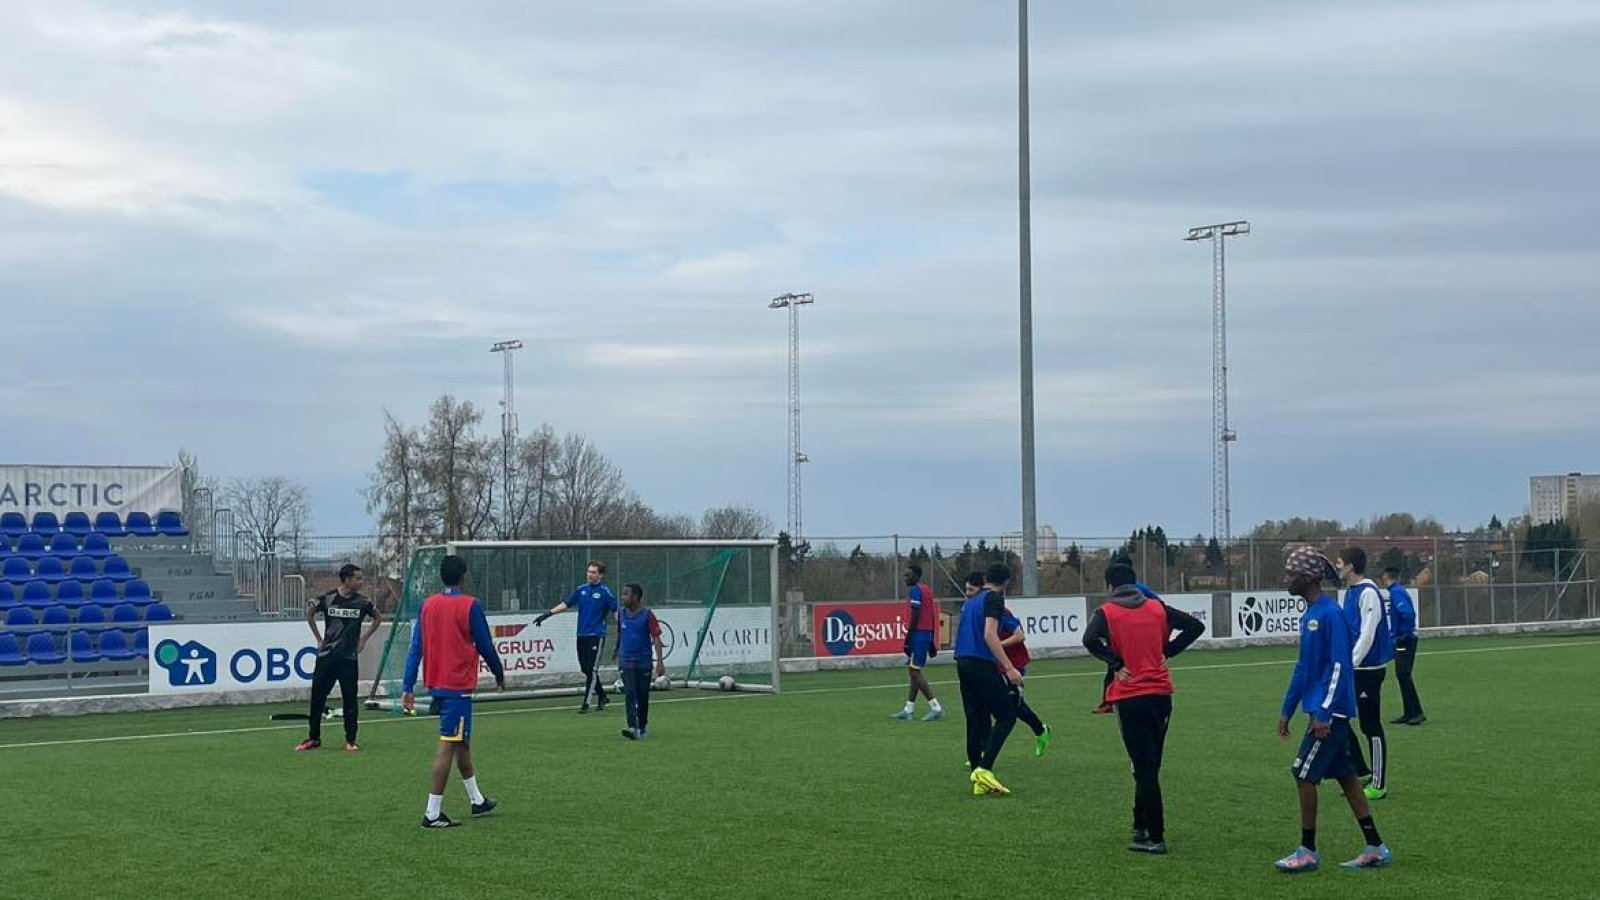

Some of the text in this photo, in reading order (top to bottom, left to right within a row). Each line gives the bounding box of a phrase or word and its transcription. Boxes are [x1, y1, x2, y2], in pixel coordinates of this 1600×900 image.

[0, 482, 124, 506] ARCTIC
[1265, 598, 1307, 614] NIPPO
[824, 616, 909, 650] Dagsavis
[1026, 615, 1079, 634] RCTIC
[1265, 617, 1299, 633] GASE
[498, 639, 555, 655] GRUTA
[480, 656, 547, 673] RLASS
